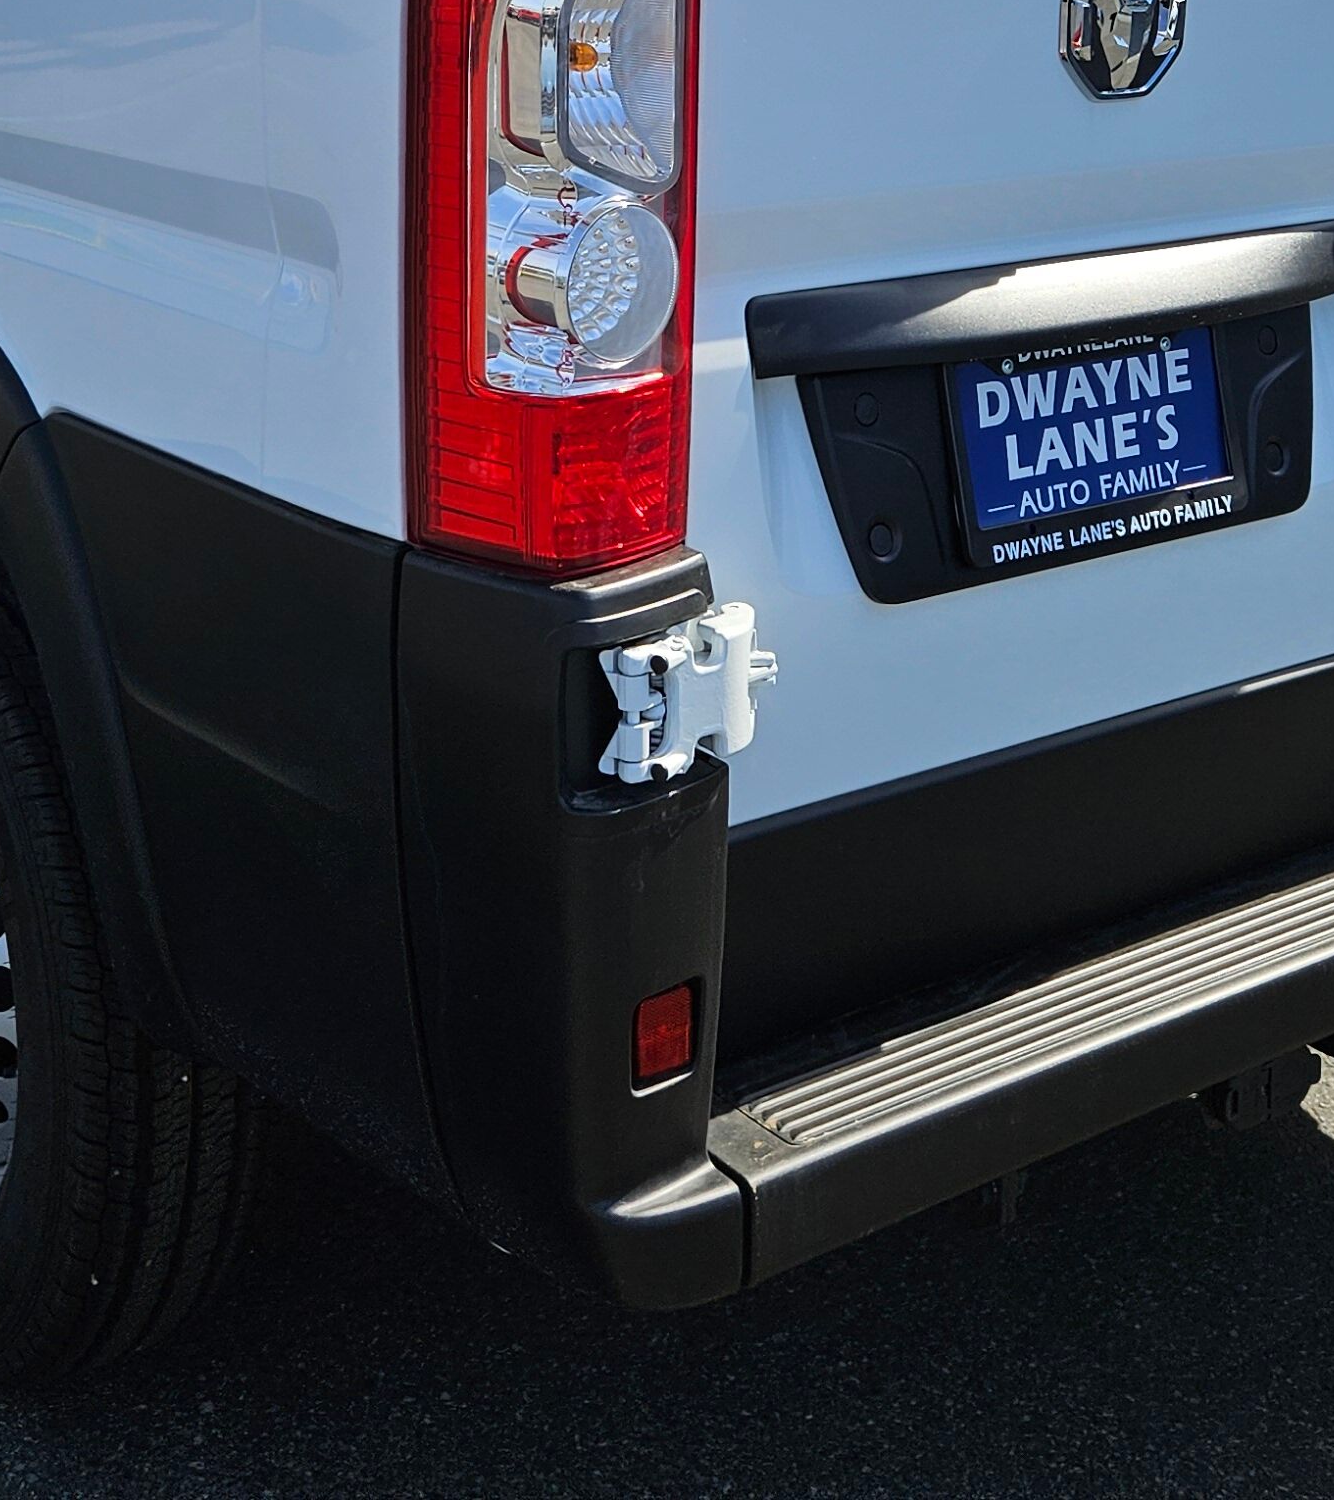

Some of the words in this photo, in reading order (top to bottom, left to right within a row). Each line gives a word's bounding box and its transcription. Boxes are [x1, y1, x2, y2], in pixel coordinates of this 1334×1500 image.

[976, 348, 1192, 429] DWAYNE
[1005, 404, 1179, 481] LANE'S
[1019, 479, 1091, 518] AUTO
[1099, 460, 1180, 500] FAMILY
[992, 532, 1065, 564] DWAYNE
[1069, 518, 1127, 547] LANE'S
[1130, 503, 1172, 534] AUTO
[1175, 494, 1233, 525] FAMILY
